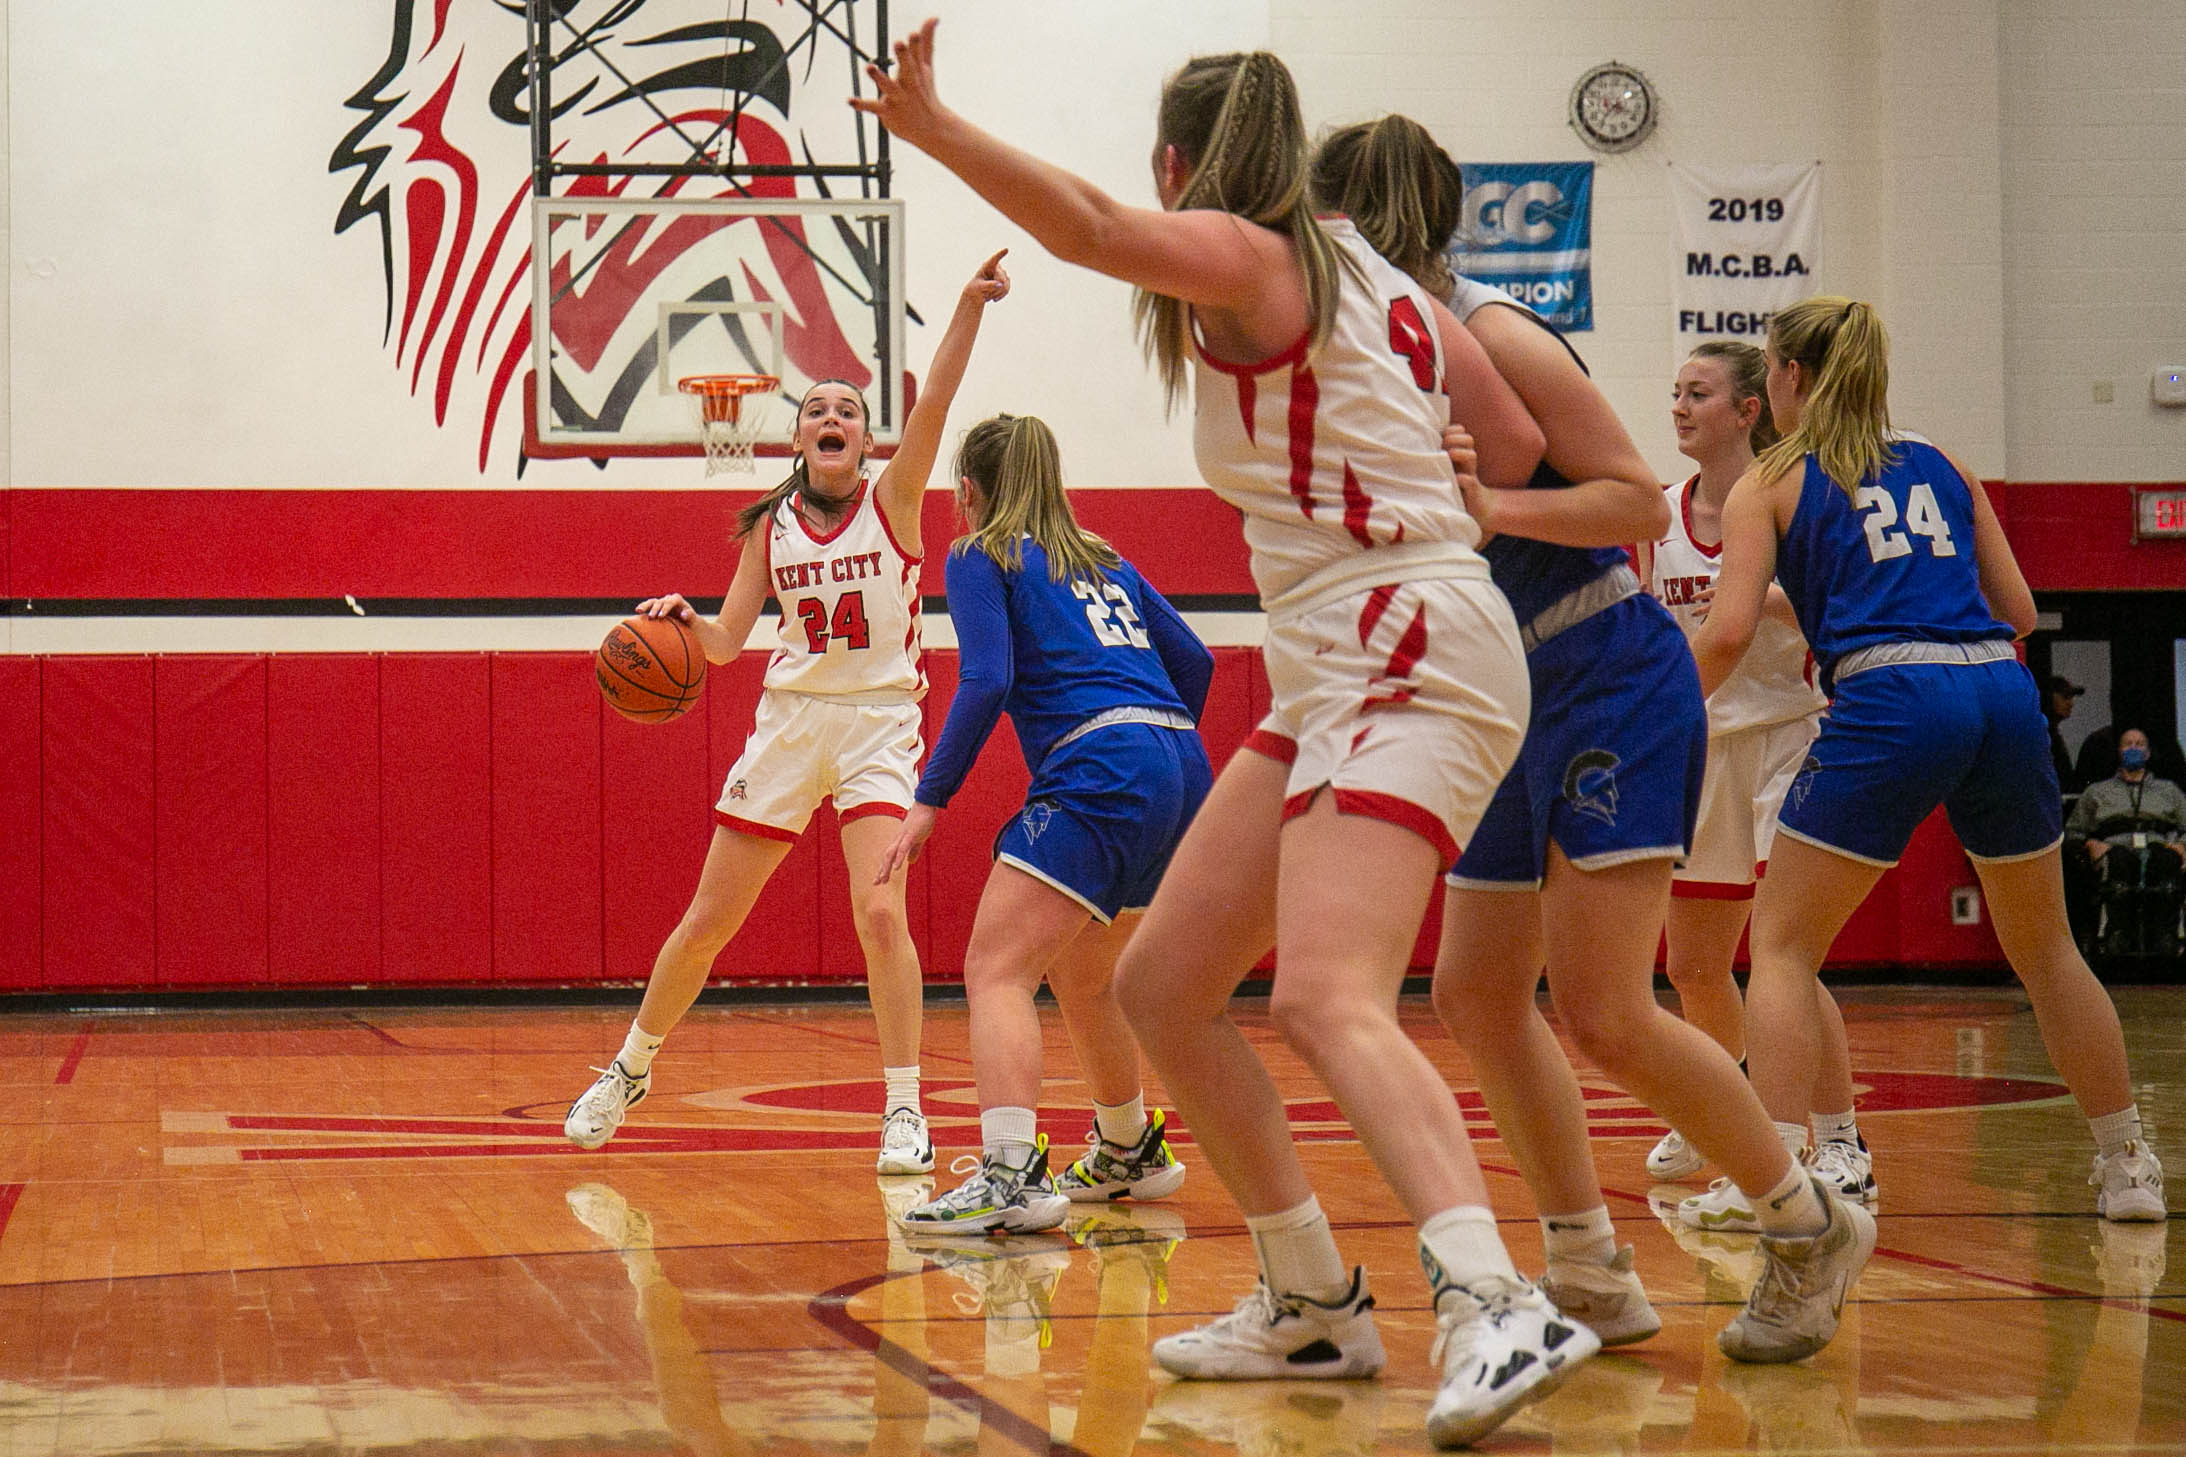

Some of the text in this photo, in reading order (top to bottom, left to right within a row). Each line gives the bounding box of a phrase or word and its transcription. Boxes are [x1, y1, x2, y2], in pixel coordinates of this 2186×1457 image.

[1462, 181, 1563, 245] GC
[1708, 198, 1784, 223] 2019
[1686, 253, 1810, 278] M.C.B.A.
[1679, 310, 1777, 335] FLIGH
[1856, 483, 1957, 564] 24
[774, 551, 882, 591] KENT CITY
[797, 590, 871, 654] 24
[1070, 580, 1151, 650] 22
